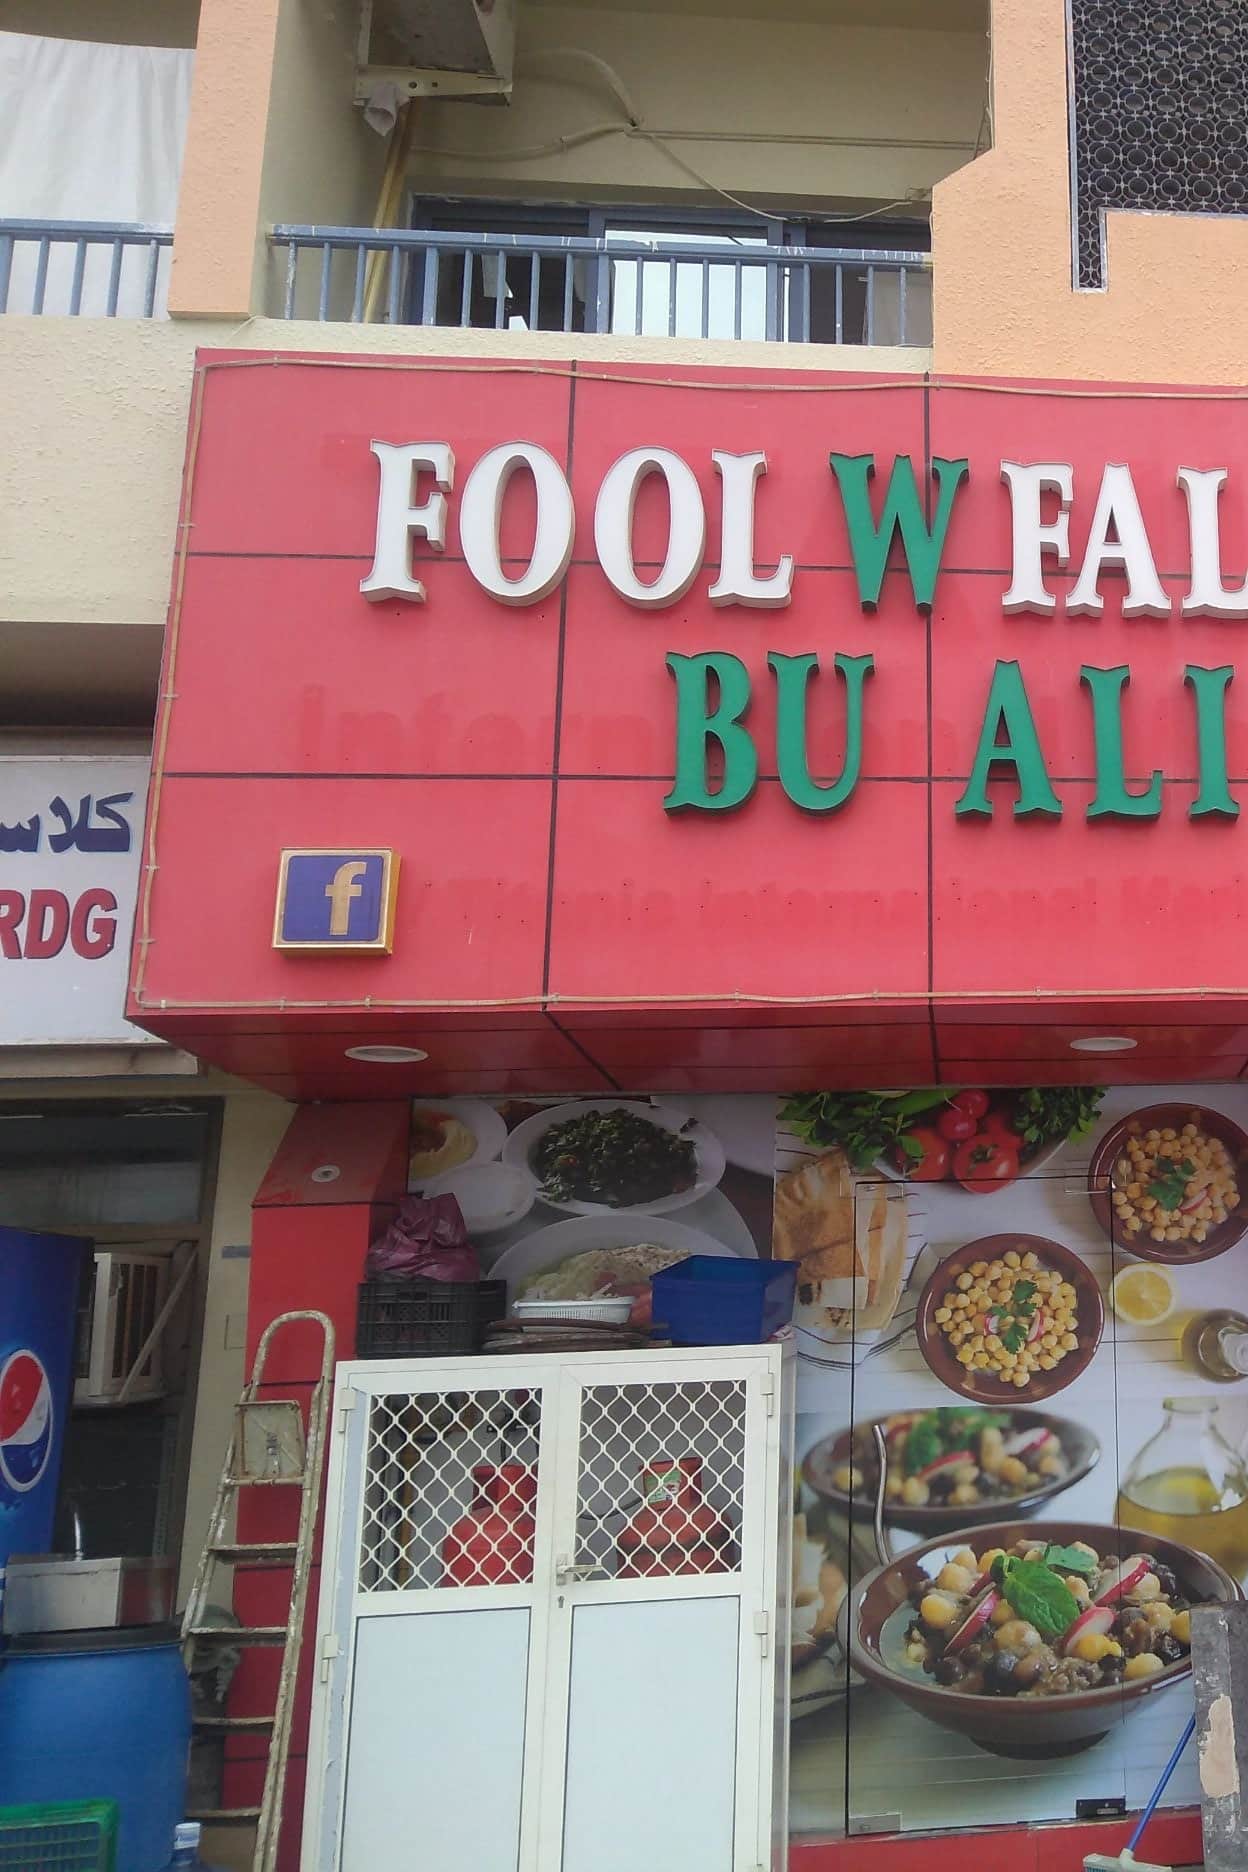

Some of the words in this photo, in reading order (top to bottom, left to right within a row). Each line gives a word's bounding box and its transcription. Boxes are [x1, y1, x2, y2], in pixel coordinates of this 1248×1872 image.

[360, 438, 796, 608] FOOL
[829, 453, 970, 612] W
[664, 651, 874, 815] BU
[955, 660, 1241, 821] ALI
[0, 887, 118, 960] RDG
